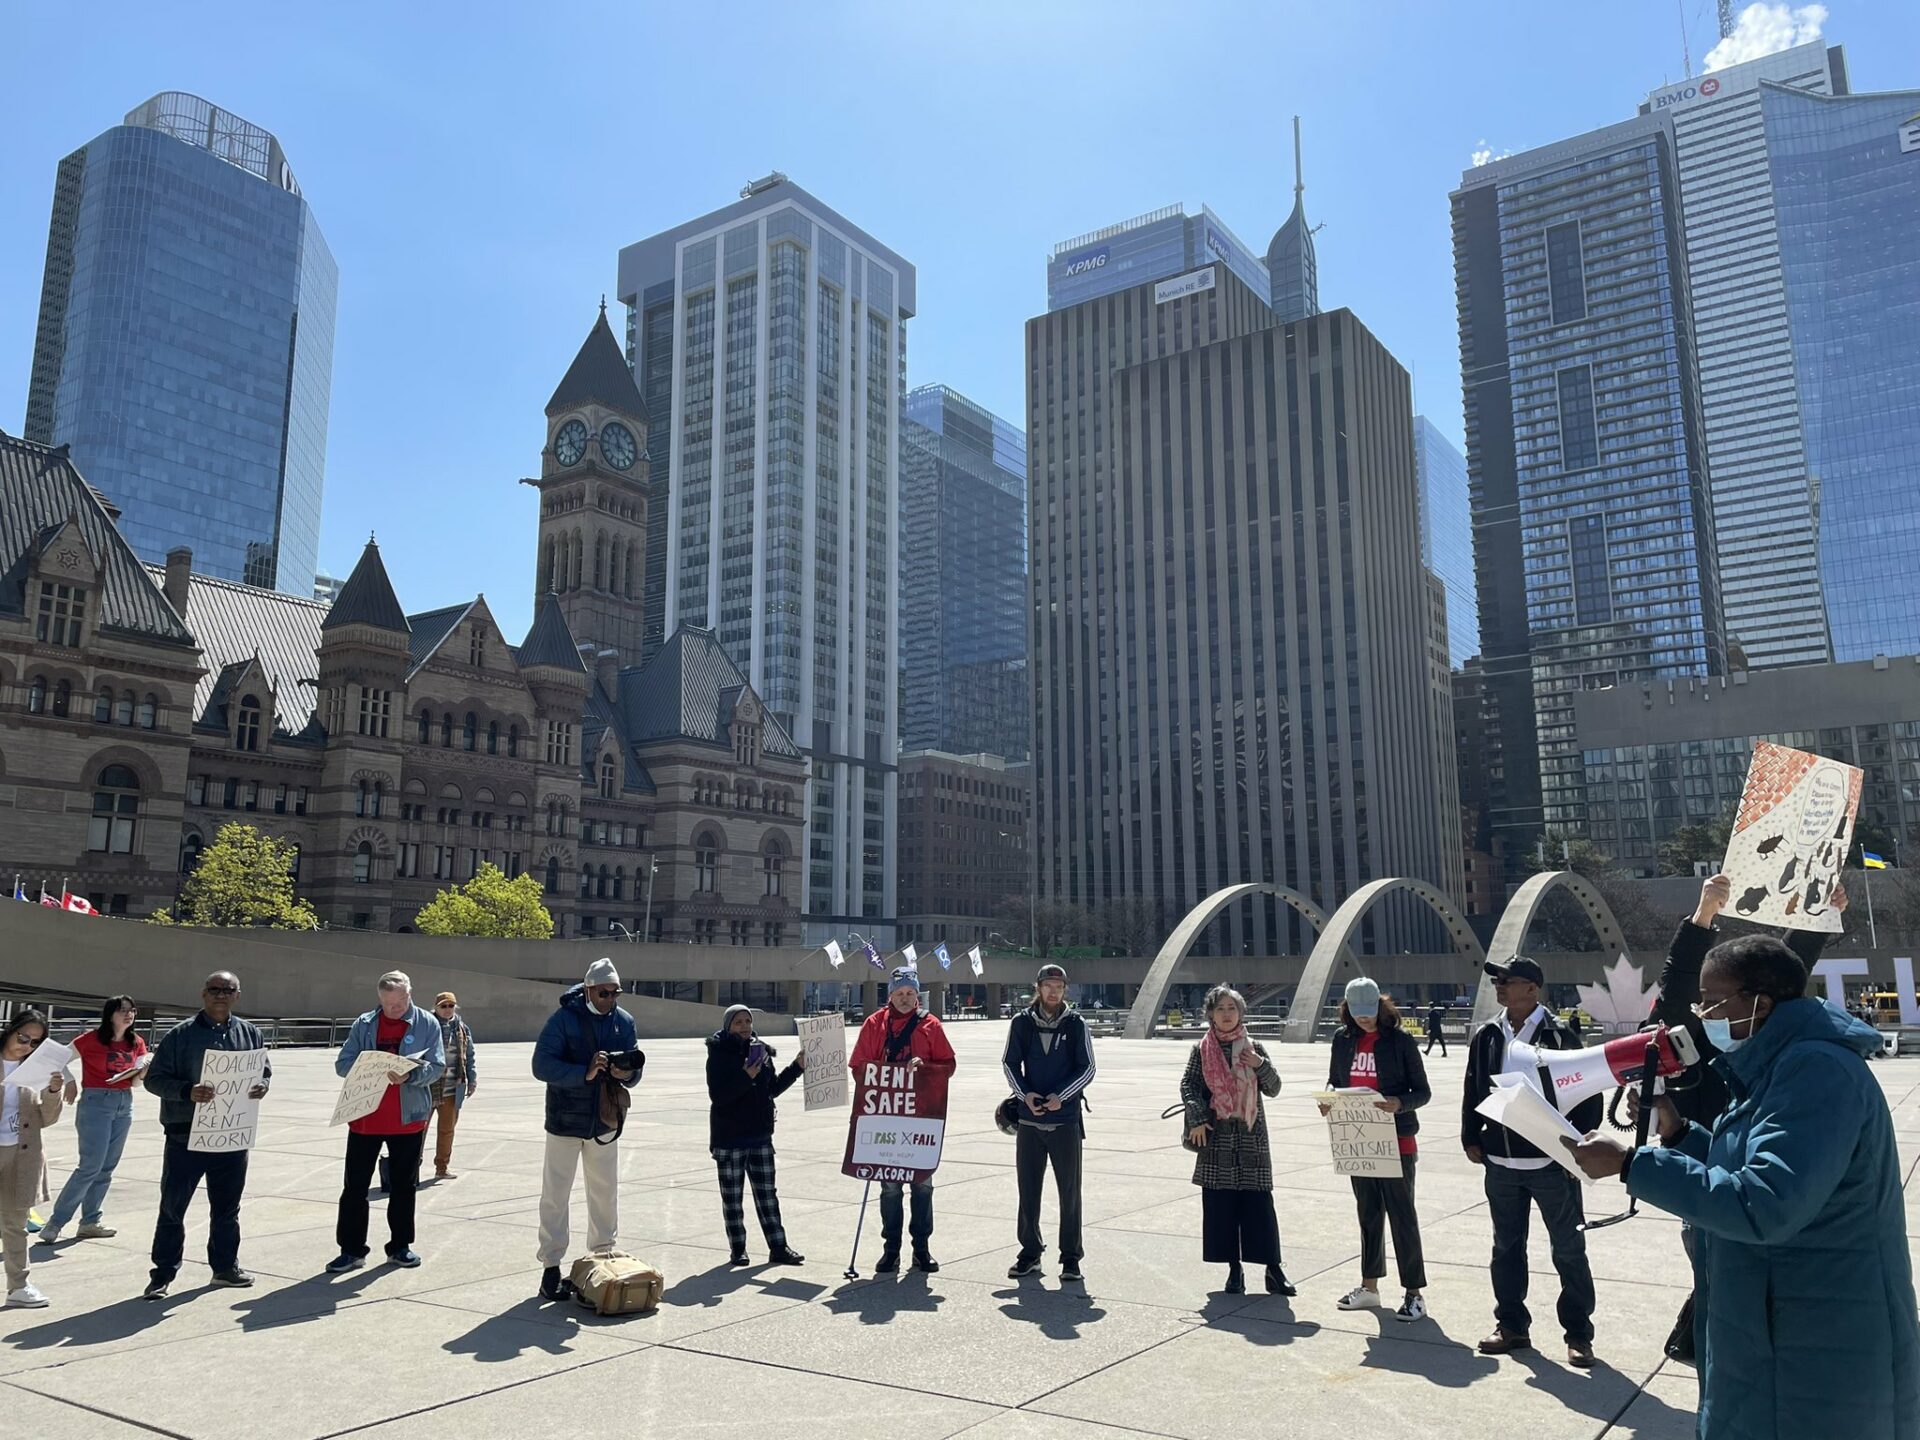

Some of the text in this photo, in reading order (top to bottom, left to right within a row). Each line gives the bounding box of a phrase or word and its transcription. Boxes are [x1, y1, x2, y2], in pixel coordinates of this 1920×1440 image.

[1656, 87, 1697, 109] BMO
[1208, 234, 1231, 263] KPMG
[1066, 254, 1107, 277] KPMG
[1158, 282, 1196, 299] Munich RE
[203, 1050, 266, 1075] ROACHES
[863, 1062, 918, 1090] RENT
[804, 1086, 841, 1107] ACORN
[863, 1089, 917, 1115] SAFE
[197, 1111, 247, 1130] RENT
[1329, 1109, 1391, 1123] TENANTS
[194, 1129, 253, 1148] ACORN
[874, 1131, 937, 1147] PASS FAIL
[1329, 1123, 1366, 1142] FIX
[873, 1167, 915, 1182] ACORN
[1336, 1160, 1377, 1172] ACORN
